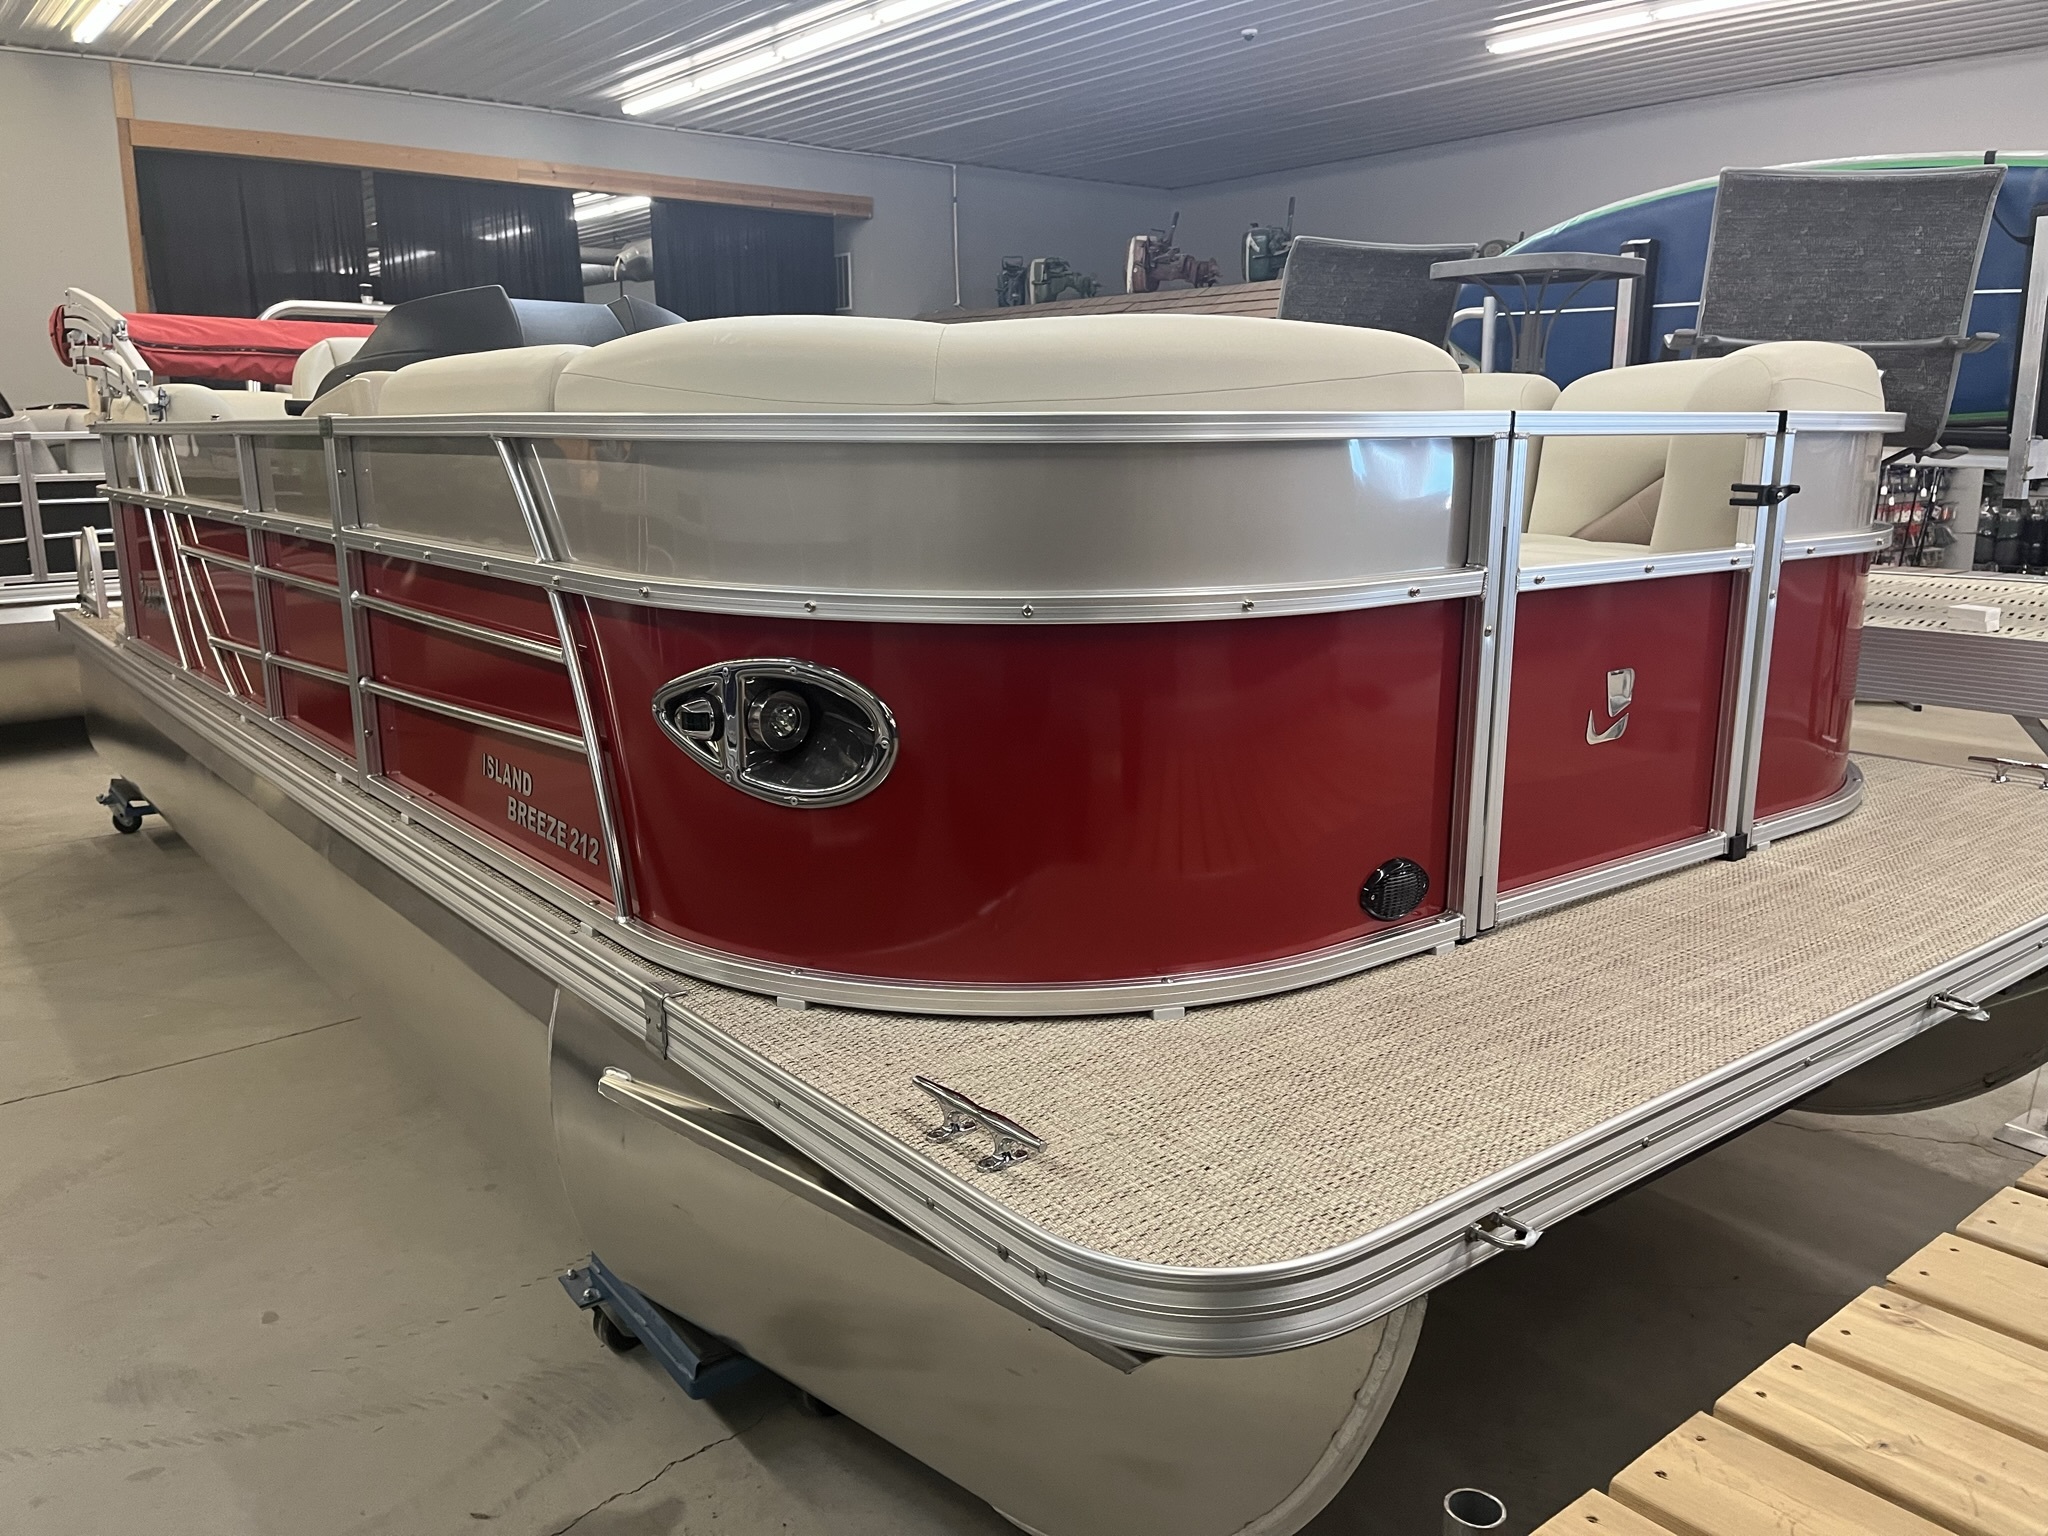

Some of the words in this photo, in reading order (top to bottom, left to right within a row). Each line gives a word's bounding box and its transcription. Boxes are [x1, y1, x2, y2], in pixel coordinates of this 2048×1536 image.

[482, 752, 532, 797] ISLAND
[507, 796, 567, 849] BREEZE
[569, 827, 599, 866] 212
